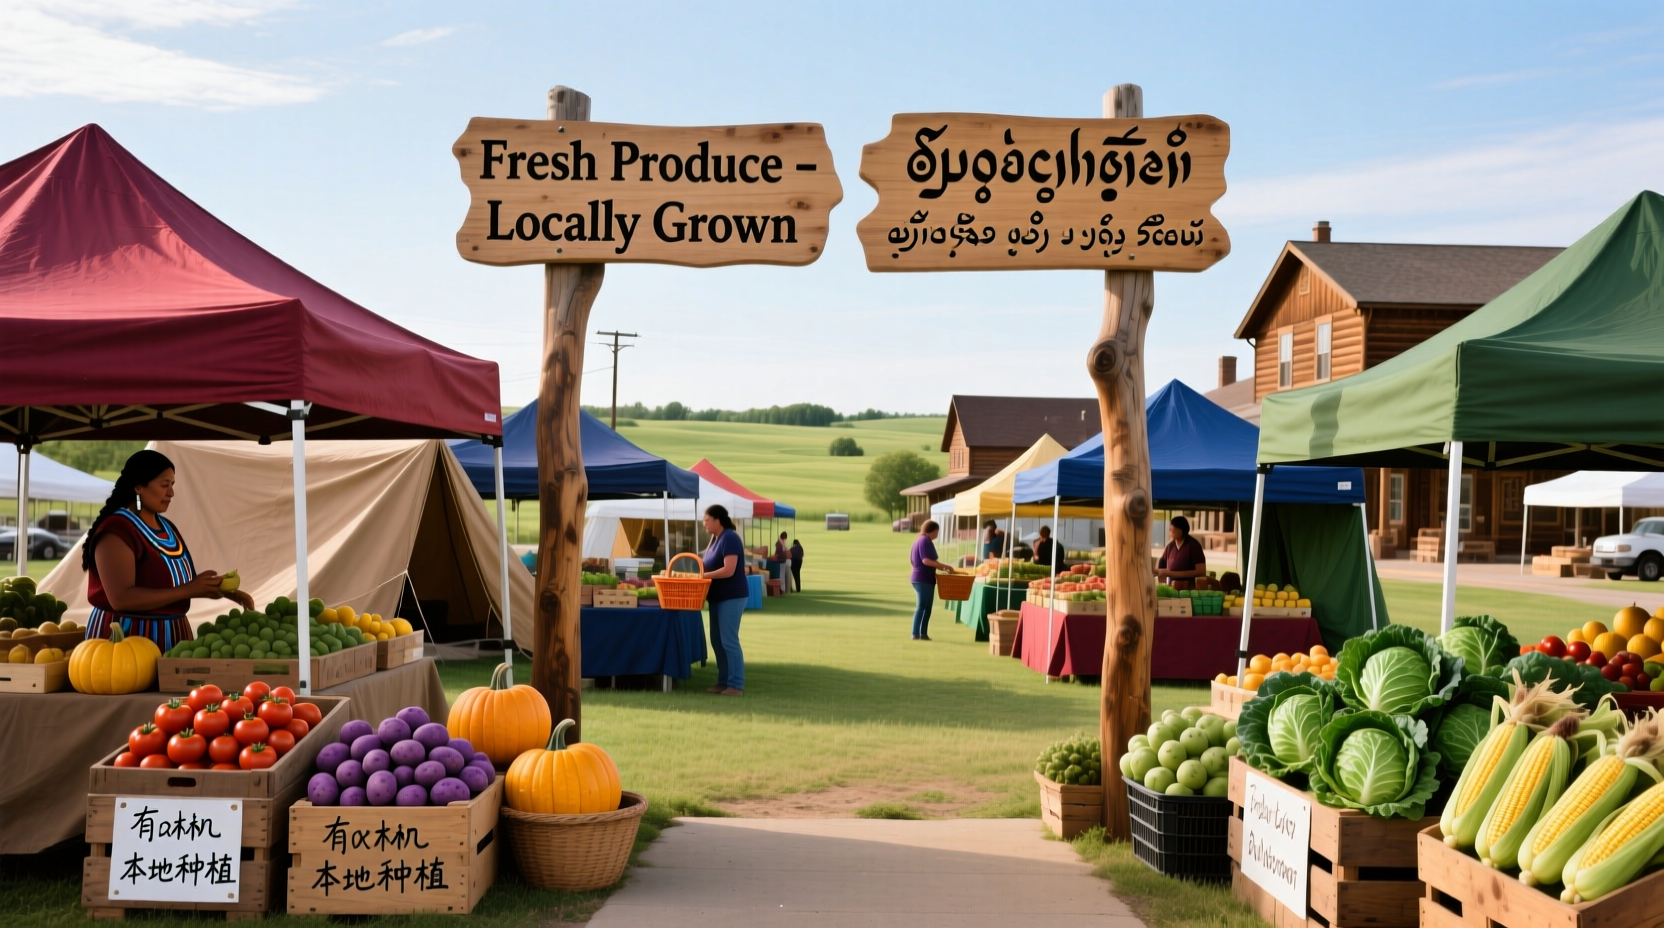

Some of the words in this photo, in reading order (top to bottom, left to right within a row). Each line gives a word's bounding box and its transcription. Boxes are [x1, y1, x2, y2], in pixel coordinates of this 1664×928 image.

[479, 139, 598, 181] Fresh
[610, 140, 783, 184] Produce
[486, 198, 642, 255] Locally
[653, 200, 798, 244] Grown
[120, 851, 237, 887] 本地种植
[311, 856, 449, 897] 本地种植
